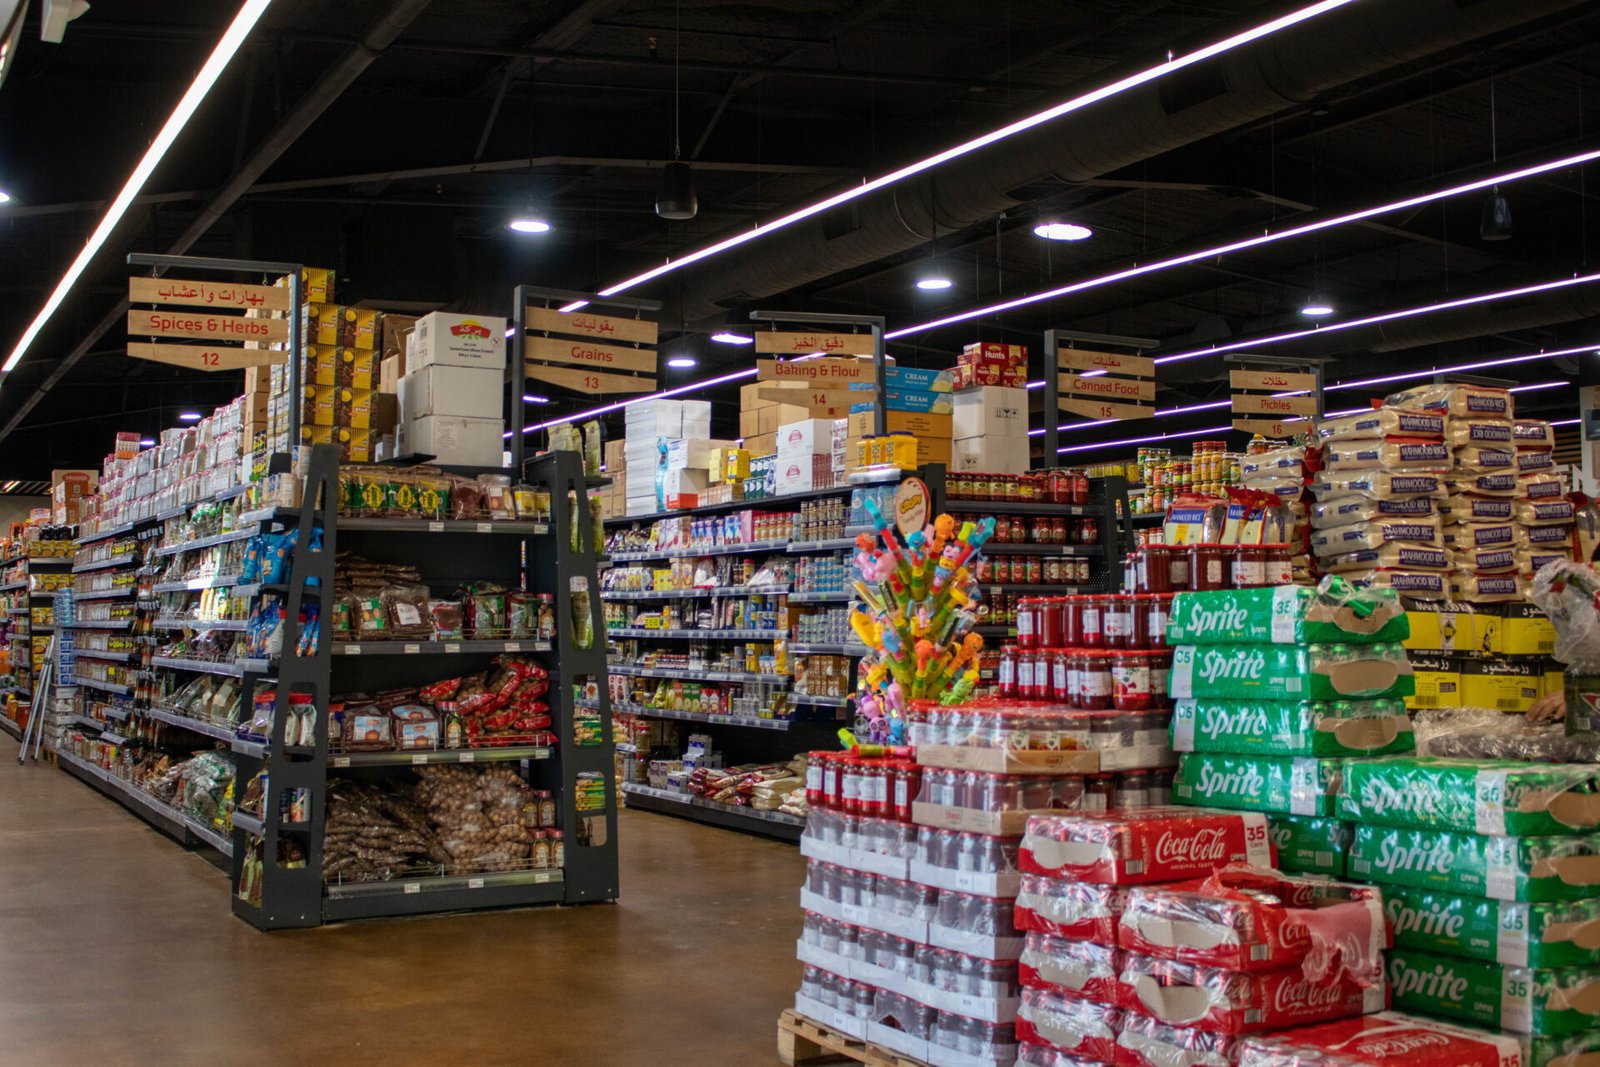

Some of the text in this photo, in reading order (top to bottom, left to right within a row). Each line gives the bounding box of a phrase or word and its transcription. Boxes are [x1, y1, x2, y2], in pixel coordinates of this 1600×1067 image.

[218, 289, 265, 306] بهارات
[150, 315, 269, 335] Spices & Herbs
[572, 318, 614, 334] بقوليات
[792, 336, 844, 351] دقيق الخبز
[201, 352, 219, 366] 12
[571, 346, 613, 362] Grains
[1093, 355, 1120, 369] معلبات
[776, 364, 861, 378] Baking & Flour
[905, 373, 928, 381] CREAM
[584, 376, 599, 389] 13
[1073, 378, 1140, 396] Canned Food
[812, 394, 826, 405] 14
[1261, 399, 1291, 410] Pickles
[1100, 406, 1112, 418] 15
[1272, 424, 1282, 435] 16
[1276, 600, 1292, 614] 35
[1186, 601, 1248, 636] Sprite
[1199, 648, 1265, 684] Sprite
[1201, 707, 1267, 740] Sprite
[1195, 765, 1264, 797] Sprite
[1362, 777, 1442, 815] Sprite
[1247, 825, 1265, 841] 35
[1155, 827, 1227, 864] Coca-Cola
[1375, 837, 1455, 874] Sprite
[1388, 899, 1465, 938] Sprite
[1503, 913, 1523, 930] 35
[1390, 958, 1468, 1001] Sprite
[1507, 979, 1528, 997] 35
